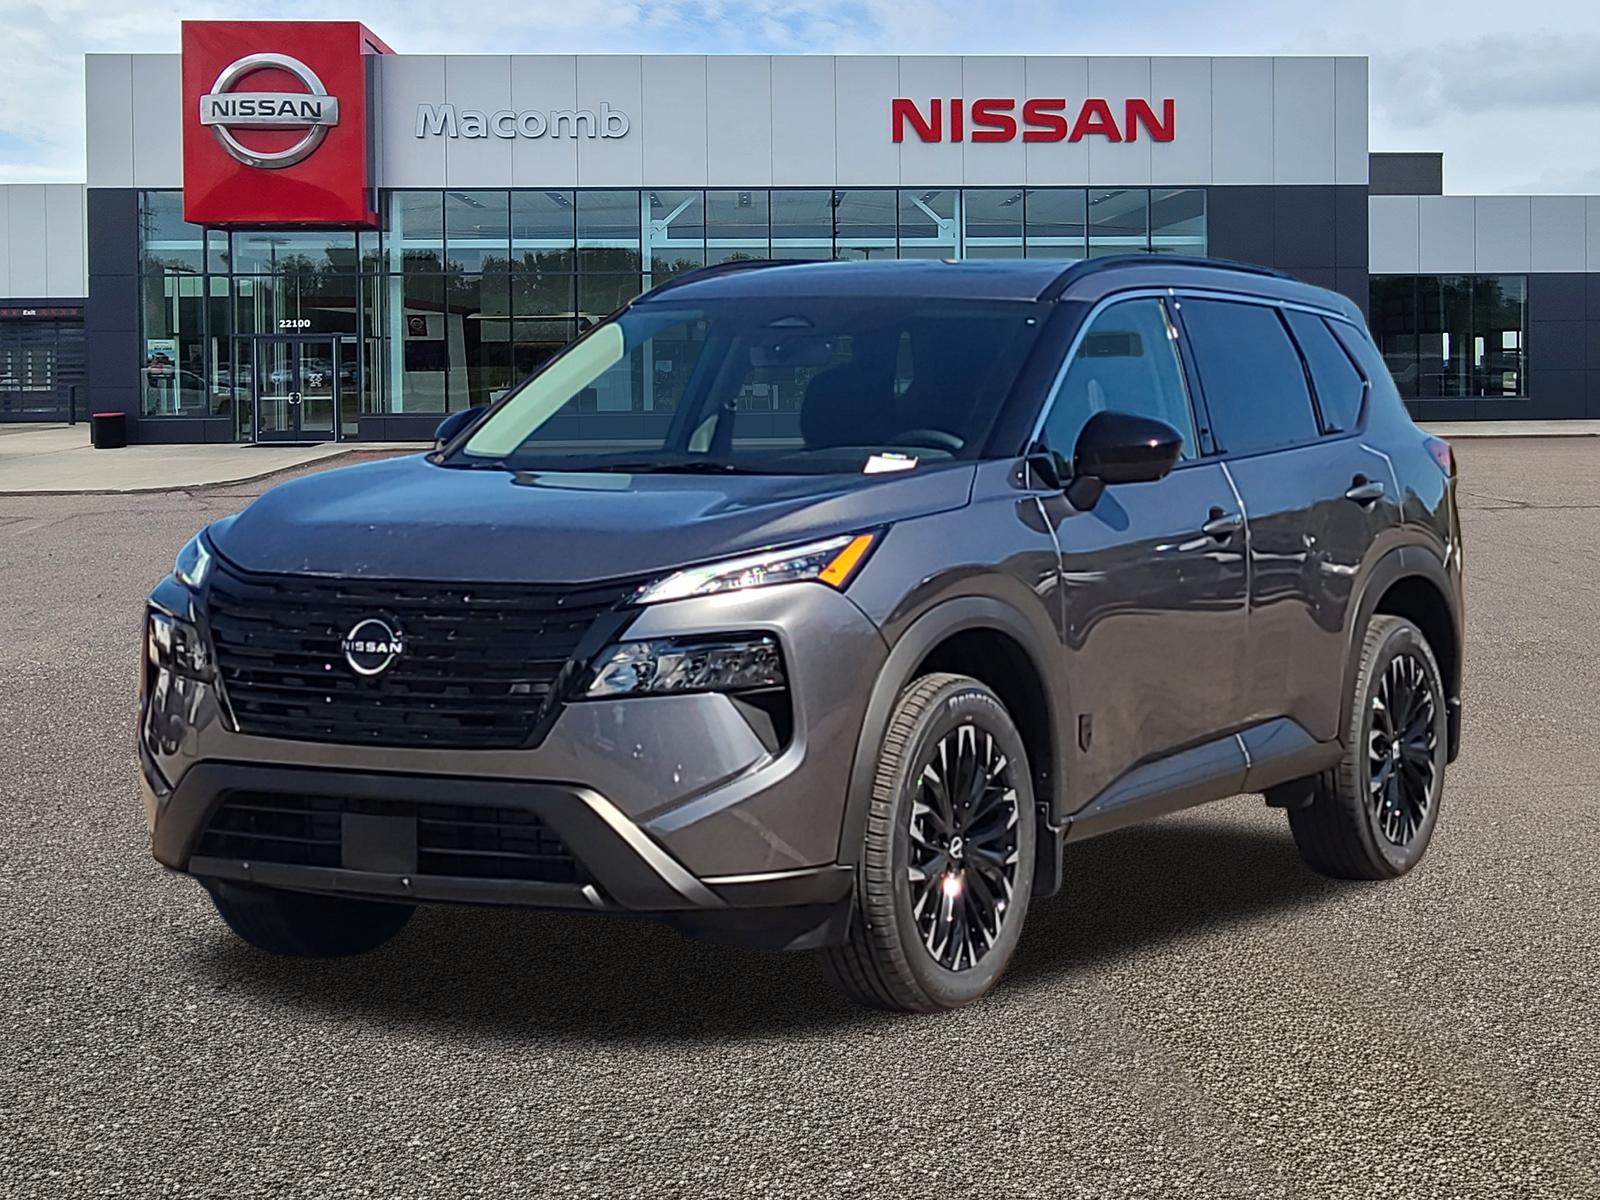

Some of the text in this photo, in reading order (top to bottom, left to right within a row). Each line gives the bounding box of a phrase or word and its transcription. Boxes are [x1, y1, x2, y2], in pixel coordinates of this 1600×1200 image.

[211, 100, 321, 117] NISSAN
[415, 102, 630, 138] Macomb
[893, 99, 1175, 142] NISSAN
[279, 319, 310, 328] 22100
[341, 640, 402, 653] NISSAN
